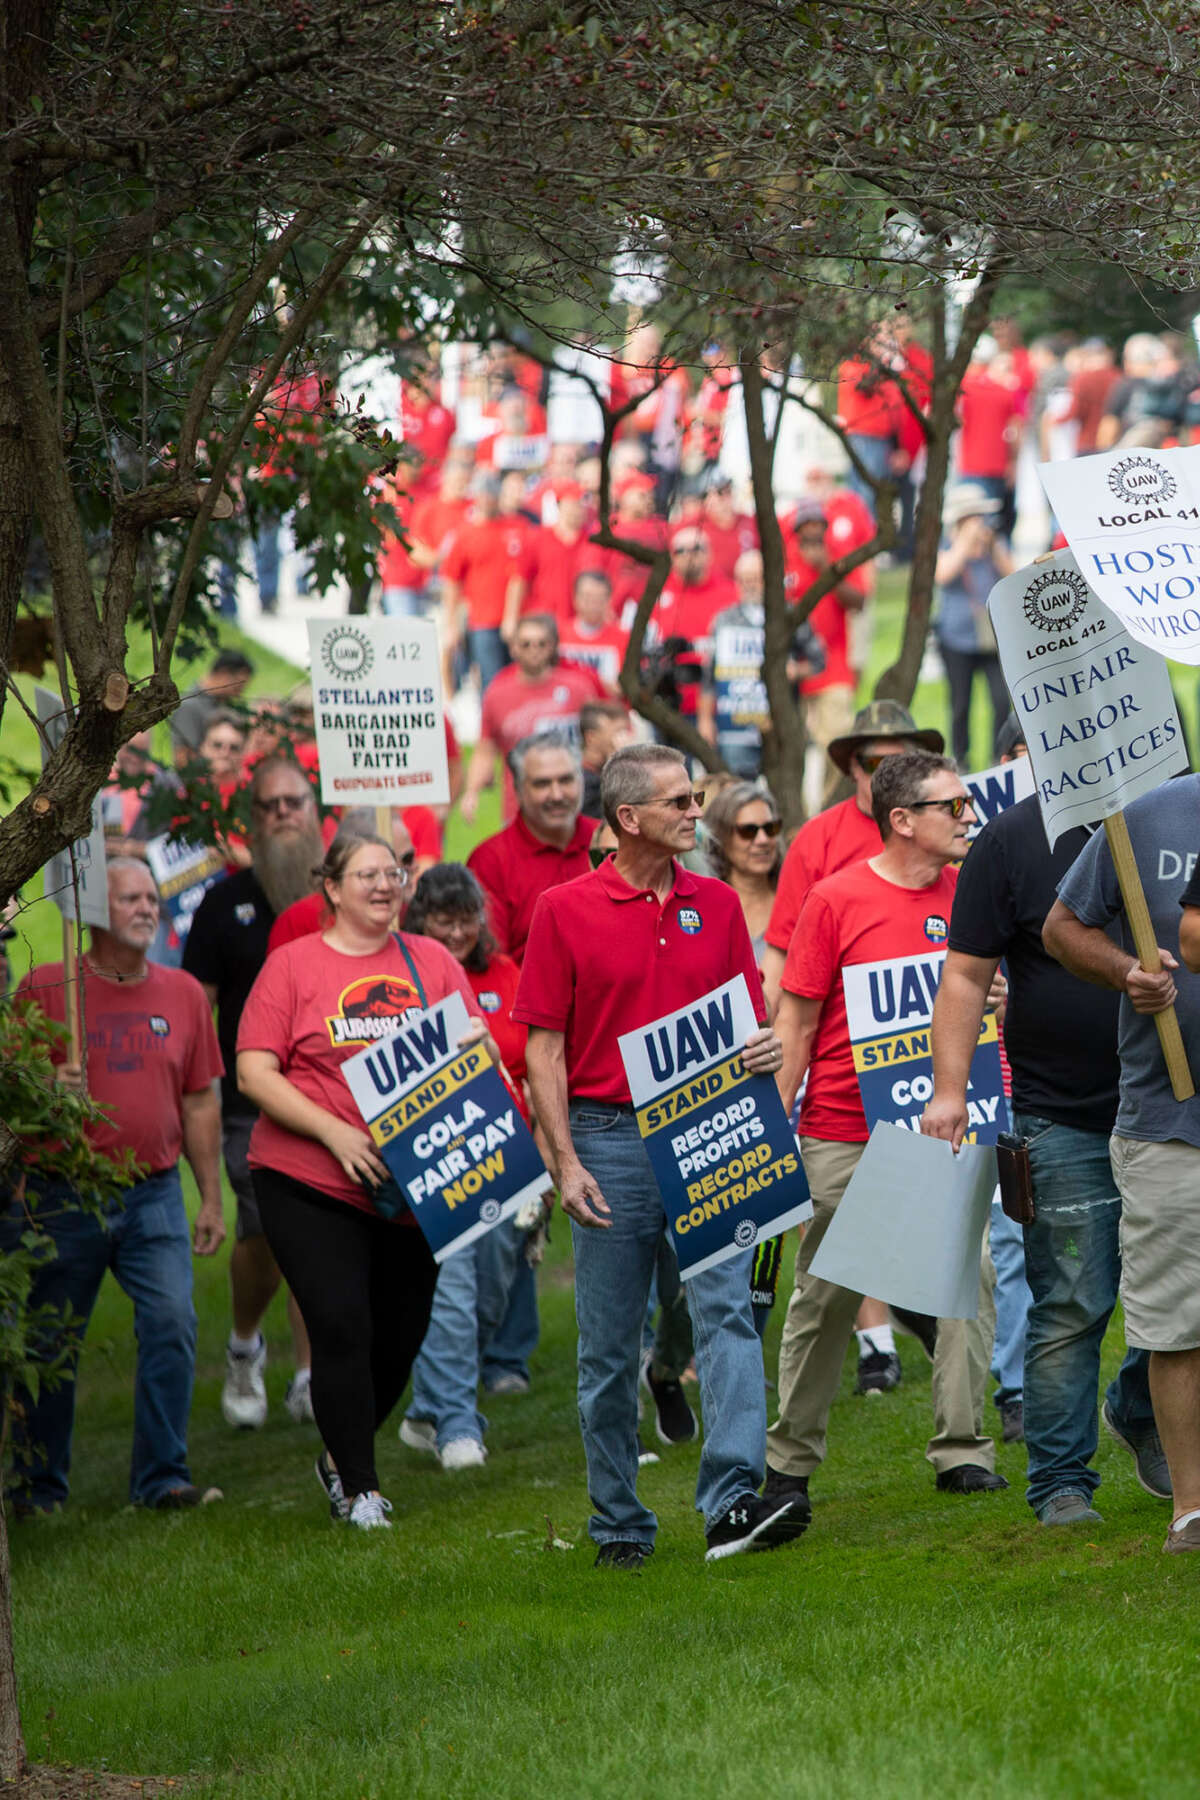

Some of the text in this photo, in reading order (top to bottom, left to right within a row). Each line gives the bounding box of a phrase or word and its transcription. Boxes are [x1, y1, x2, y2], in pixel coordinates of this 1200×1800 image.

[1126, 474, 1159, 490] UAW
[1098, 507, 1172, 528] LOCAL
[1041, 591, 1071, 612] UAW
[335, 648, 360, 660] UAW
[386, 642, 422, 661] 412
[1026, 619, 1107, 661] LOCAL 412
[318, 687, 435, 705] STELLANTIS
[1020, 646, 1138, 713] UNFAIR
[321, 712, 436, 730] BARGAINING
[348, 733, 411, 749] IN BAD
[1040, 693, 1143, 754] LABOR
[352, 752, 408, 768] FAITH
[1037, 717, 1177, 804] RACTICES
[363, 1009, 450, 1096] UAW
[643, 991, 736, 1083] UAW
[861, 1034, 930, 1067] STAN
[379, 1053, 481, 1138] STAND UP
[647, 1061, 744, 1130] STAND U
[966, 1095, 1000, 1130] AY
[406, 1108, 517, 1206] FAIR PAY
[412, 1098, 487, 1160] COLA
[671, 1096, 757, 1158] RECORD
[678, 1116, 765, 1181] PROFITS
[441, 1149, 507, 1211] NOW
[674, 1152, 799, 1236] CONTRACTS
[686, 1142, 773, 1205] RECORD
[751, 1290, 773, 1305] CING
